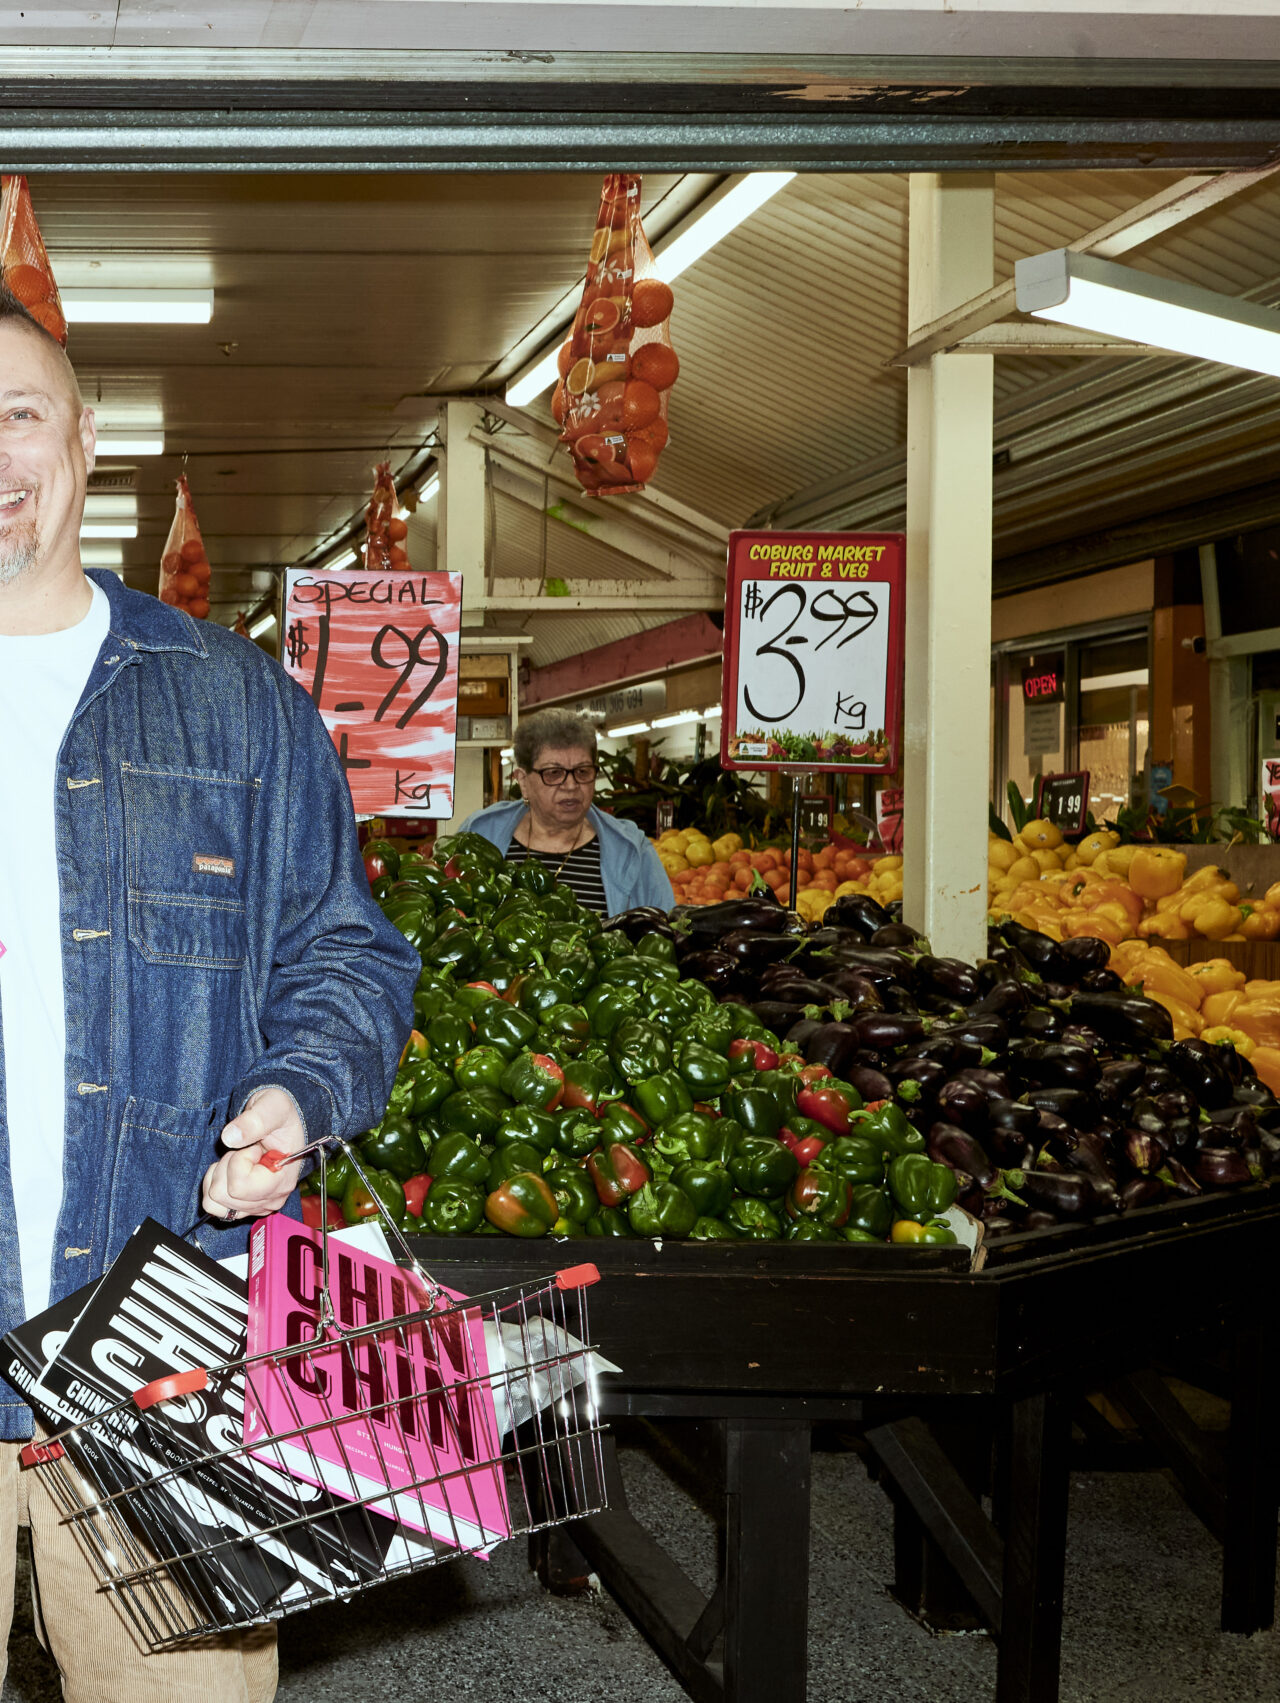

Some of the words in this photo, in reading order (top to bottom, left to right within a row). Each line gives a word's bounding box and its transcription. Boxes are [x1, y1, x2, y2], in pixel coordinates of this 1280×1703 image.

[749, 544, 814, 561] COBURG
[817, 546, 886, 562] MARKET
[769, 562, 816, 578] FRUIT
[821, 563, 833, 578] &
[839, 563, 870, 578] VEG
[1024, 672, 1057, 698] OPEN
[834, 691, 867, 730] Kg
[394, 769, 432, 810] Kg
[287, 1234, 468, 1377] CHIN
[91, 1243, 248, 1424] CHIN
[286, 1311, 480, 1464] CHIN
[83, 1443, 99, 1461] BOOK
[164, 1448, 186, 1465] BOOK
[229, 1491, 255, 1511] ENJAMIN
[255, 1509, 275, 1525] COOER
